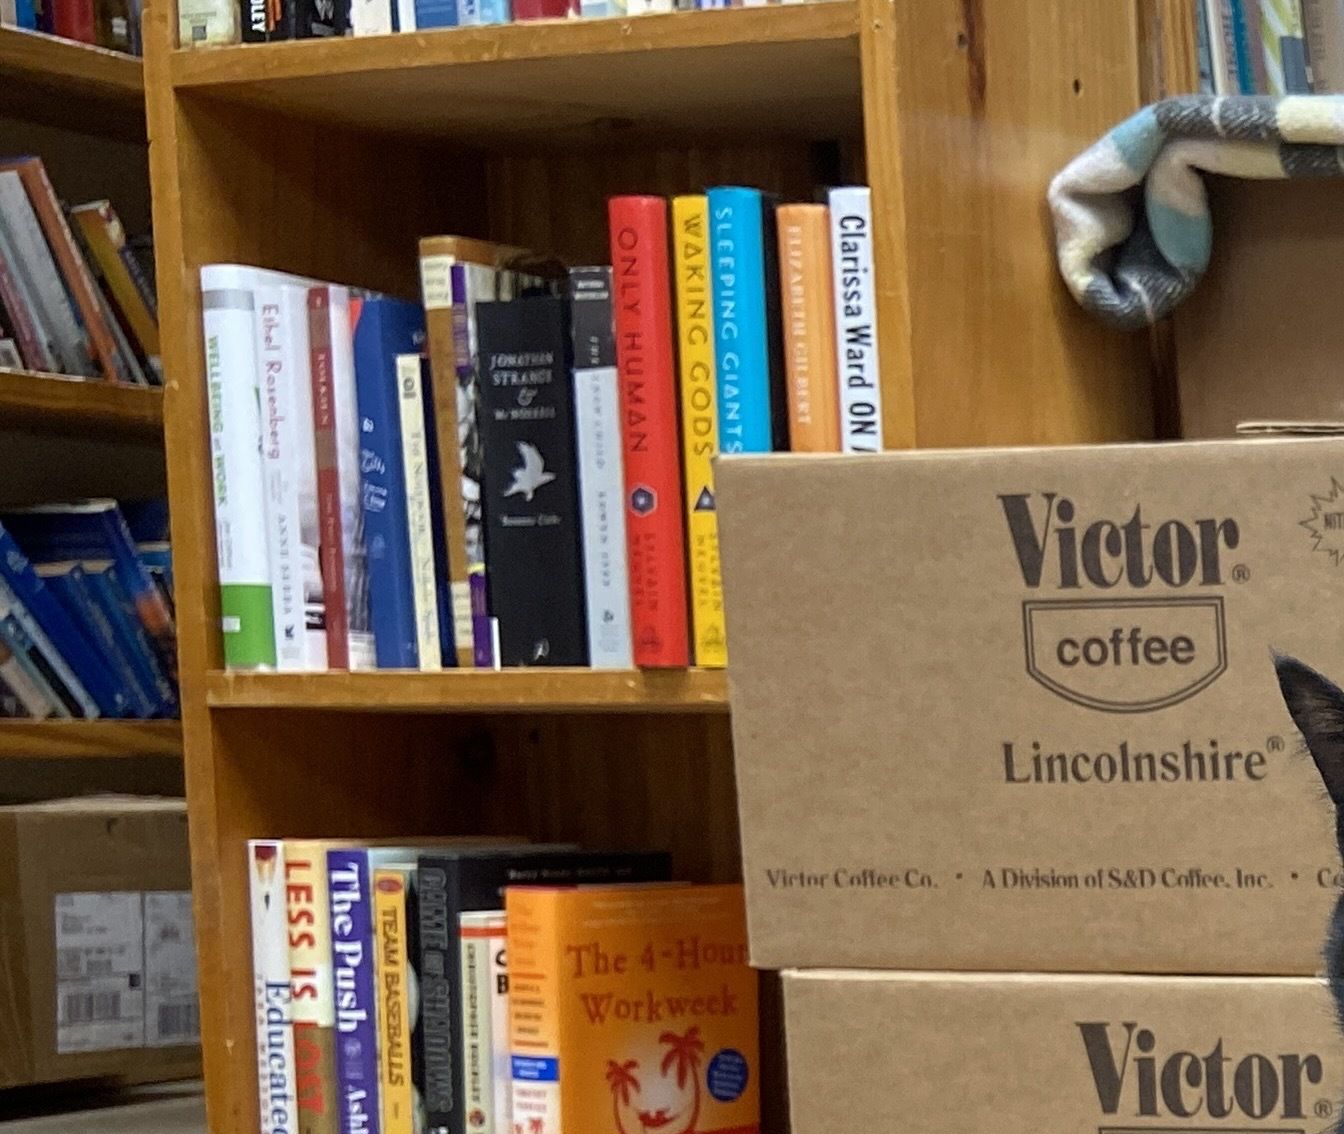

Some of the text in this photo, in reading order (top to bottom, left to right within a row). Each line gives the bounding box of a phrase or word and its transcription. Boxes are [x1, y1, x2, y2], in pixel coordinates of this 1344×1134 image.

[840, 215, 866, 317] Clarissa
[262, 304, 281, 350] Ethel
[617, 227, 648, 453] ONLY HUMAN
[683, 214, 714, 457] WAKING GODS
[715, 207, 743, 453] SLEEPING GIANTS
[788, 226, 811, 425] ELIZABETH GILBERT
[845, 325, 873, 389] Ward
[208, 336, 224, 433] WELLBEING
[266, 361, 285, 459] Rosenberg
[849, 402, 877, 434] ON
[214, 456, 228, 506] WORK
[1056, 628, 1196, 668] coffee
[329, 861, 362, 938] The
[766, 868, 828, 889] Victor
[834, 867, 900, 889] Coffee
[904, 868, 939, 889] Co.
[982, 869, 996, 889] A
[1001, 867, 1079, 890] Division
[1084, 867, 1104, 889] of
[1108, 867, 1157, 889] S&D
[285, 859, 325, 1115] LESS IS LOST
[335, 940, 367, 1033] Push
[382, 905, 405, 1087] TEAM BASEBALLS
[568, 942, 627, 978] The
[579, 985, 738, 1024] Workweek
